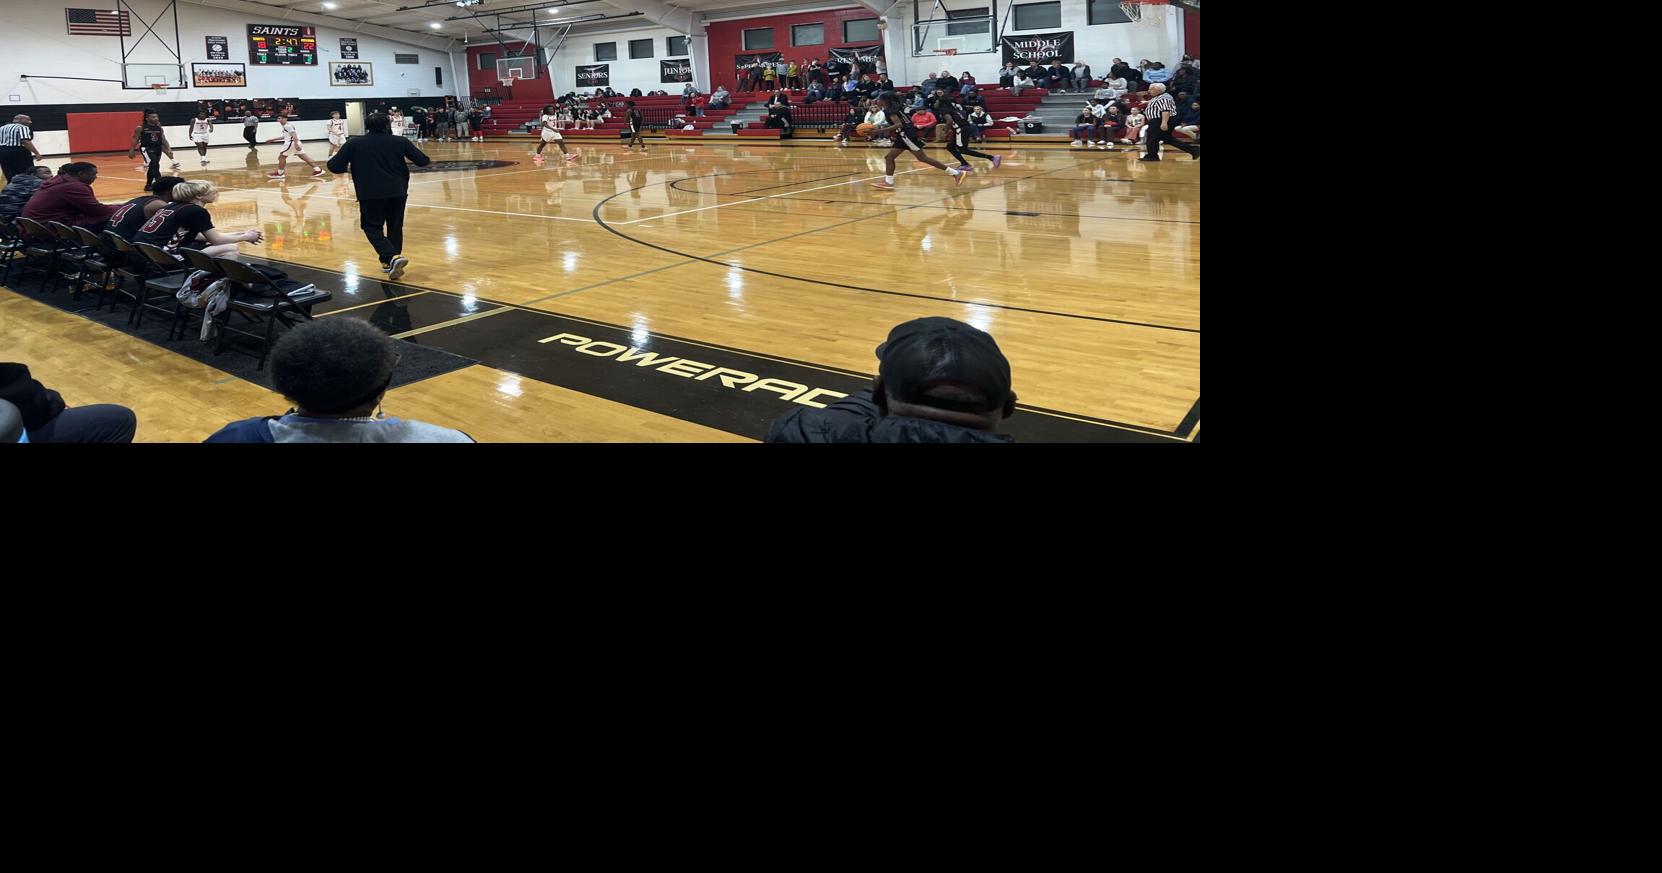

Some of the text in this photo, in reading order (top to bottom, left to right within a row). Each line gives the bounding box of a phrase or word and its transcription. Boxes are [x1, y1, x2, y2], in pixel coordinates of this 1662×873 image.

[252, 26, 299, 36] SAINTS
[275, 37, 298, 46] 2:47
[1014, 39, 1060, 48] MIDDLE
[1013, 50, 1062, 59] SCHOOL
[577, 71, 609, 80] SENIORS
[110, 203, 136, 227] 4
